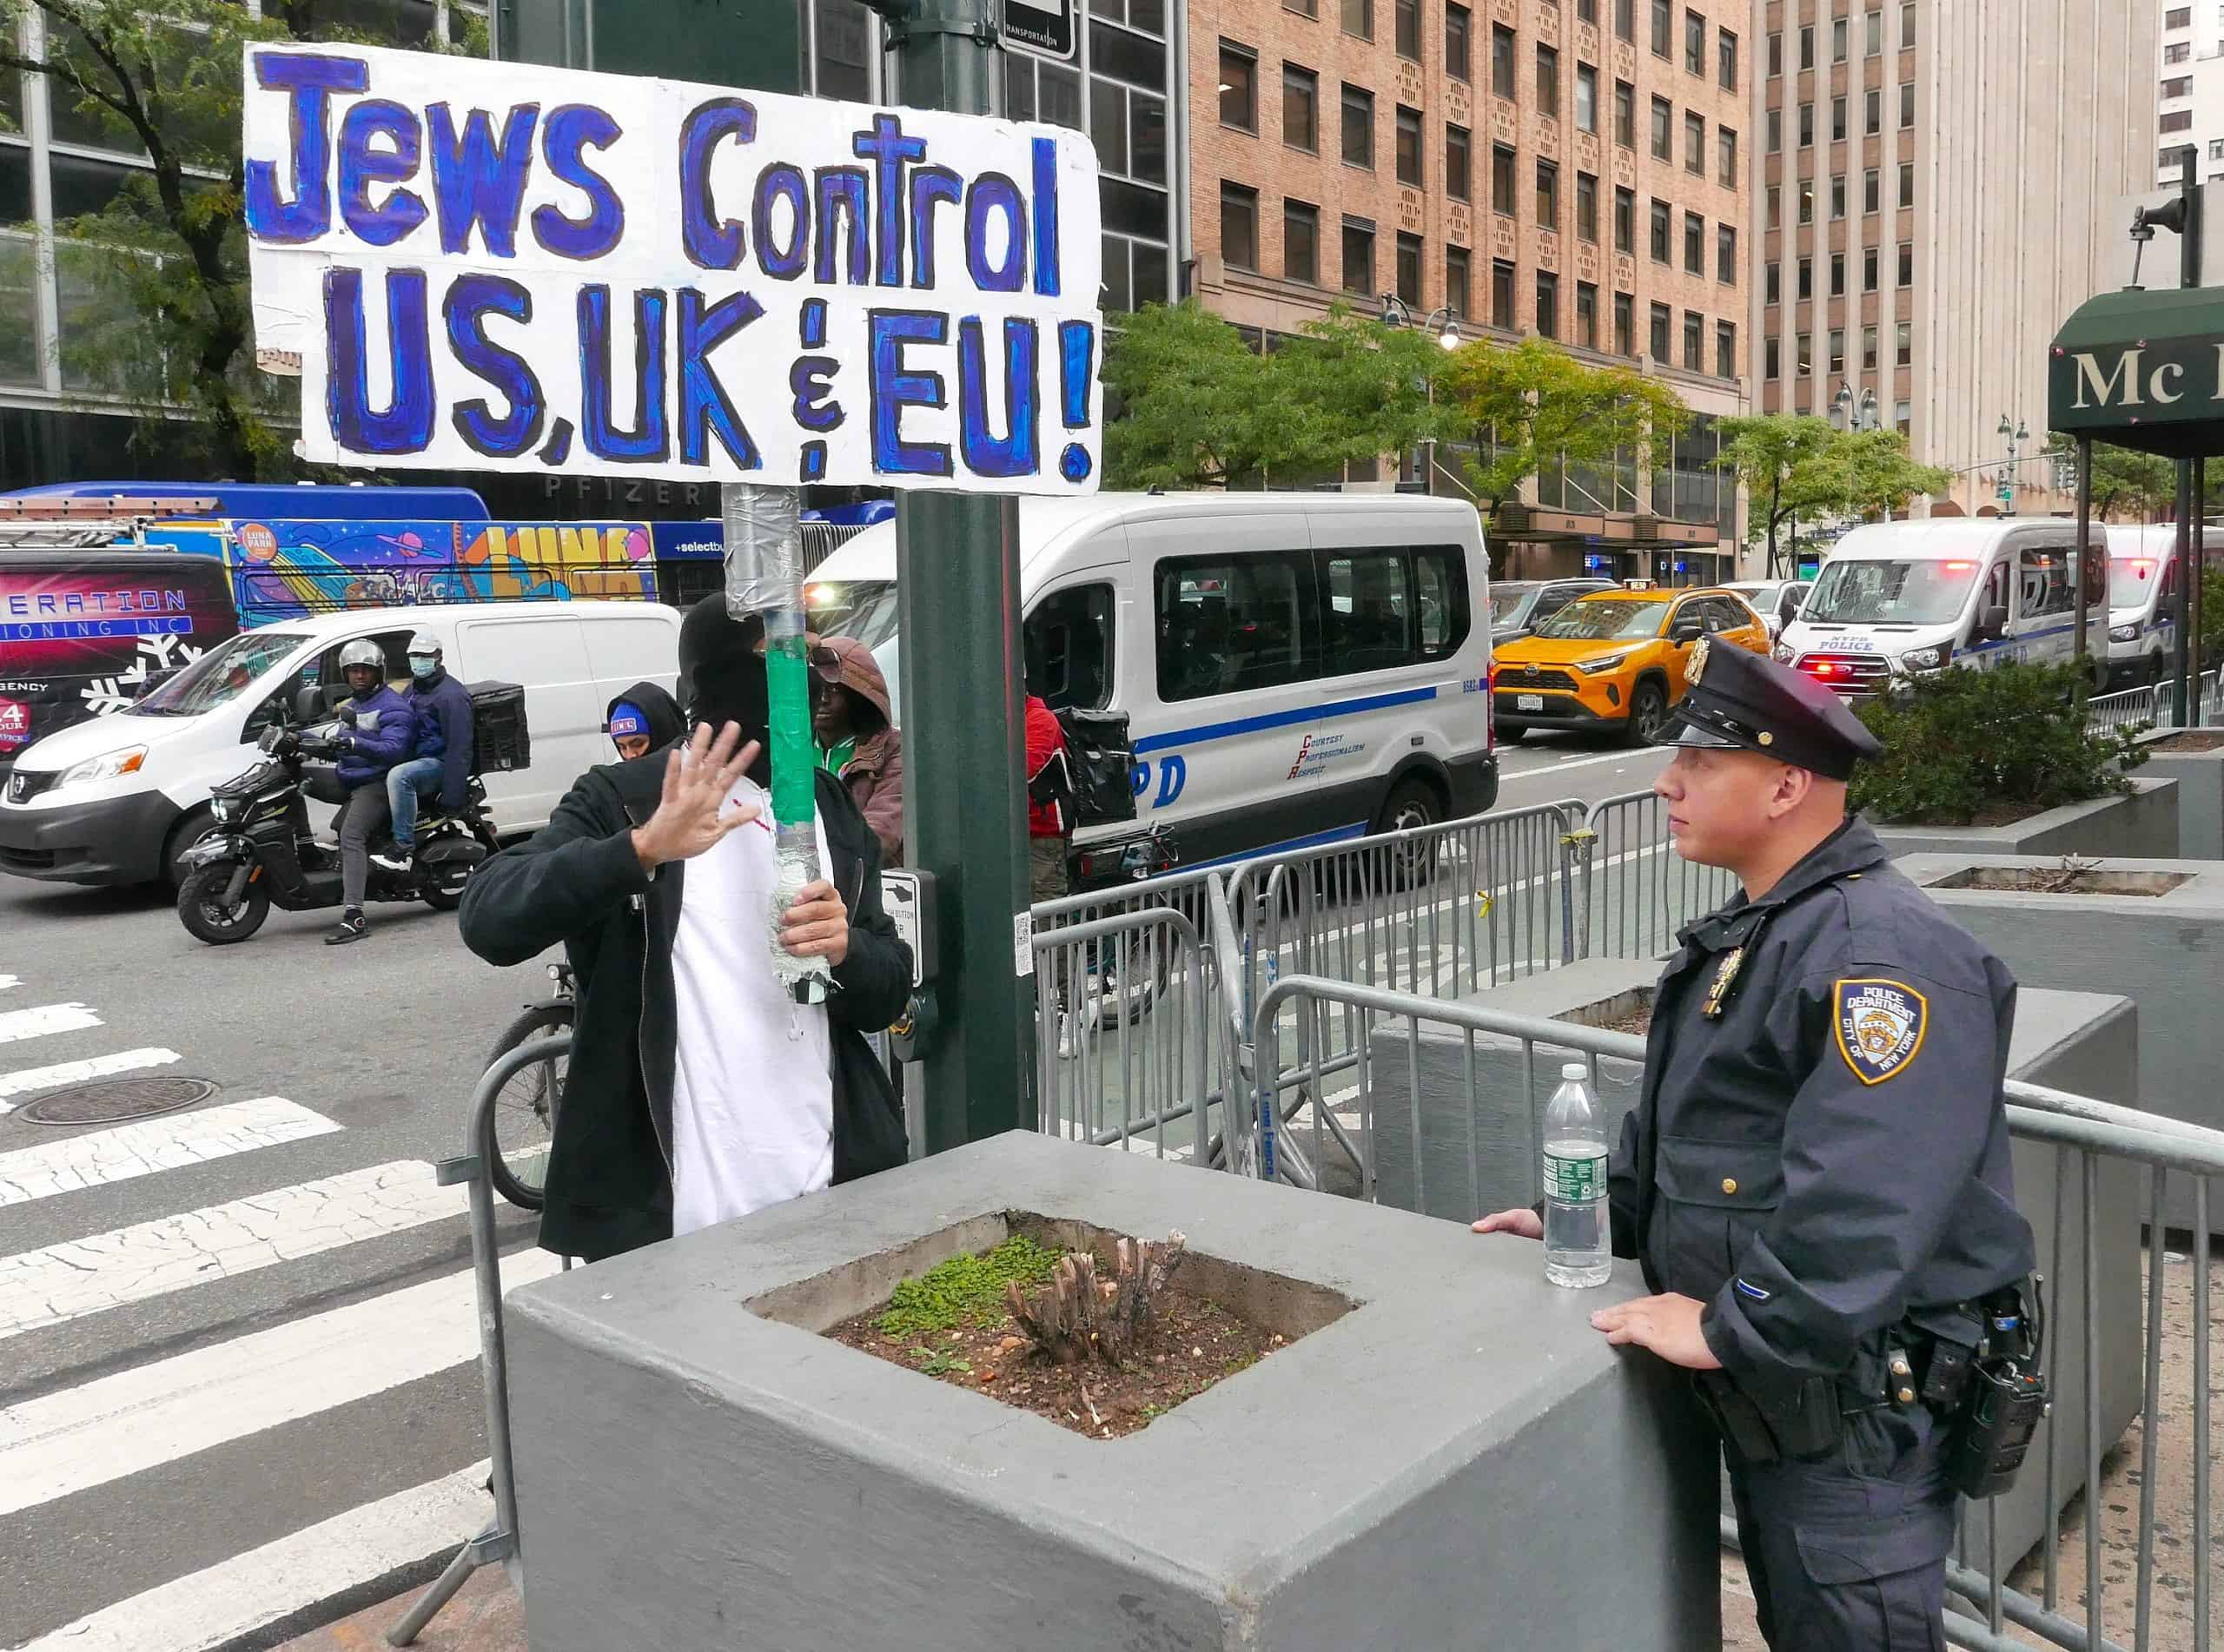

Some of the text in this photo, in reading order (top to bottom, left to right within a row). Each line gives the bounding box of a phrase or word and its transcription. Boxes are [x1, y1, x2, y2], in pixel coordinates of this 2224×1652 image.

[245, 51, 1061, 297] Jews Control
[2070, 349, 2184, 408] Mc
[868, 307, 1095, 484] EU!
[545, 476, 702, 506] PFIZER
[9, 590, 187, 615] ERATION
[3, 618, 181, 639] IONING INC
[1820, 641, 1874, 651] POLICE
[0, 704, 24, 723] 4
[1296, 743, 1365, 764] PROFESSIONALISM
[1302, 735, 1344, 749] COURTESY
[1287, 765, 1327, 780] RESPECT
[1863, 987, 1905, 1005] POLICE
[1847, 997, 1916, 1023] DEPARTMENT
[1842, 1018, 1865, 1059] CITY OF
[1878, 1029, 1917, 1072] NEW YORK
